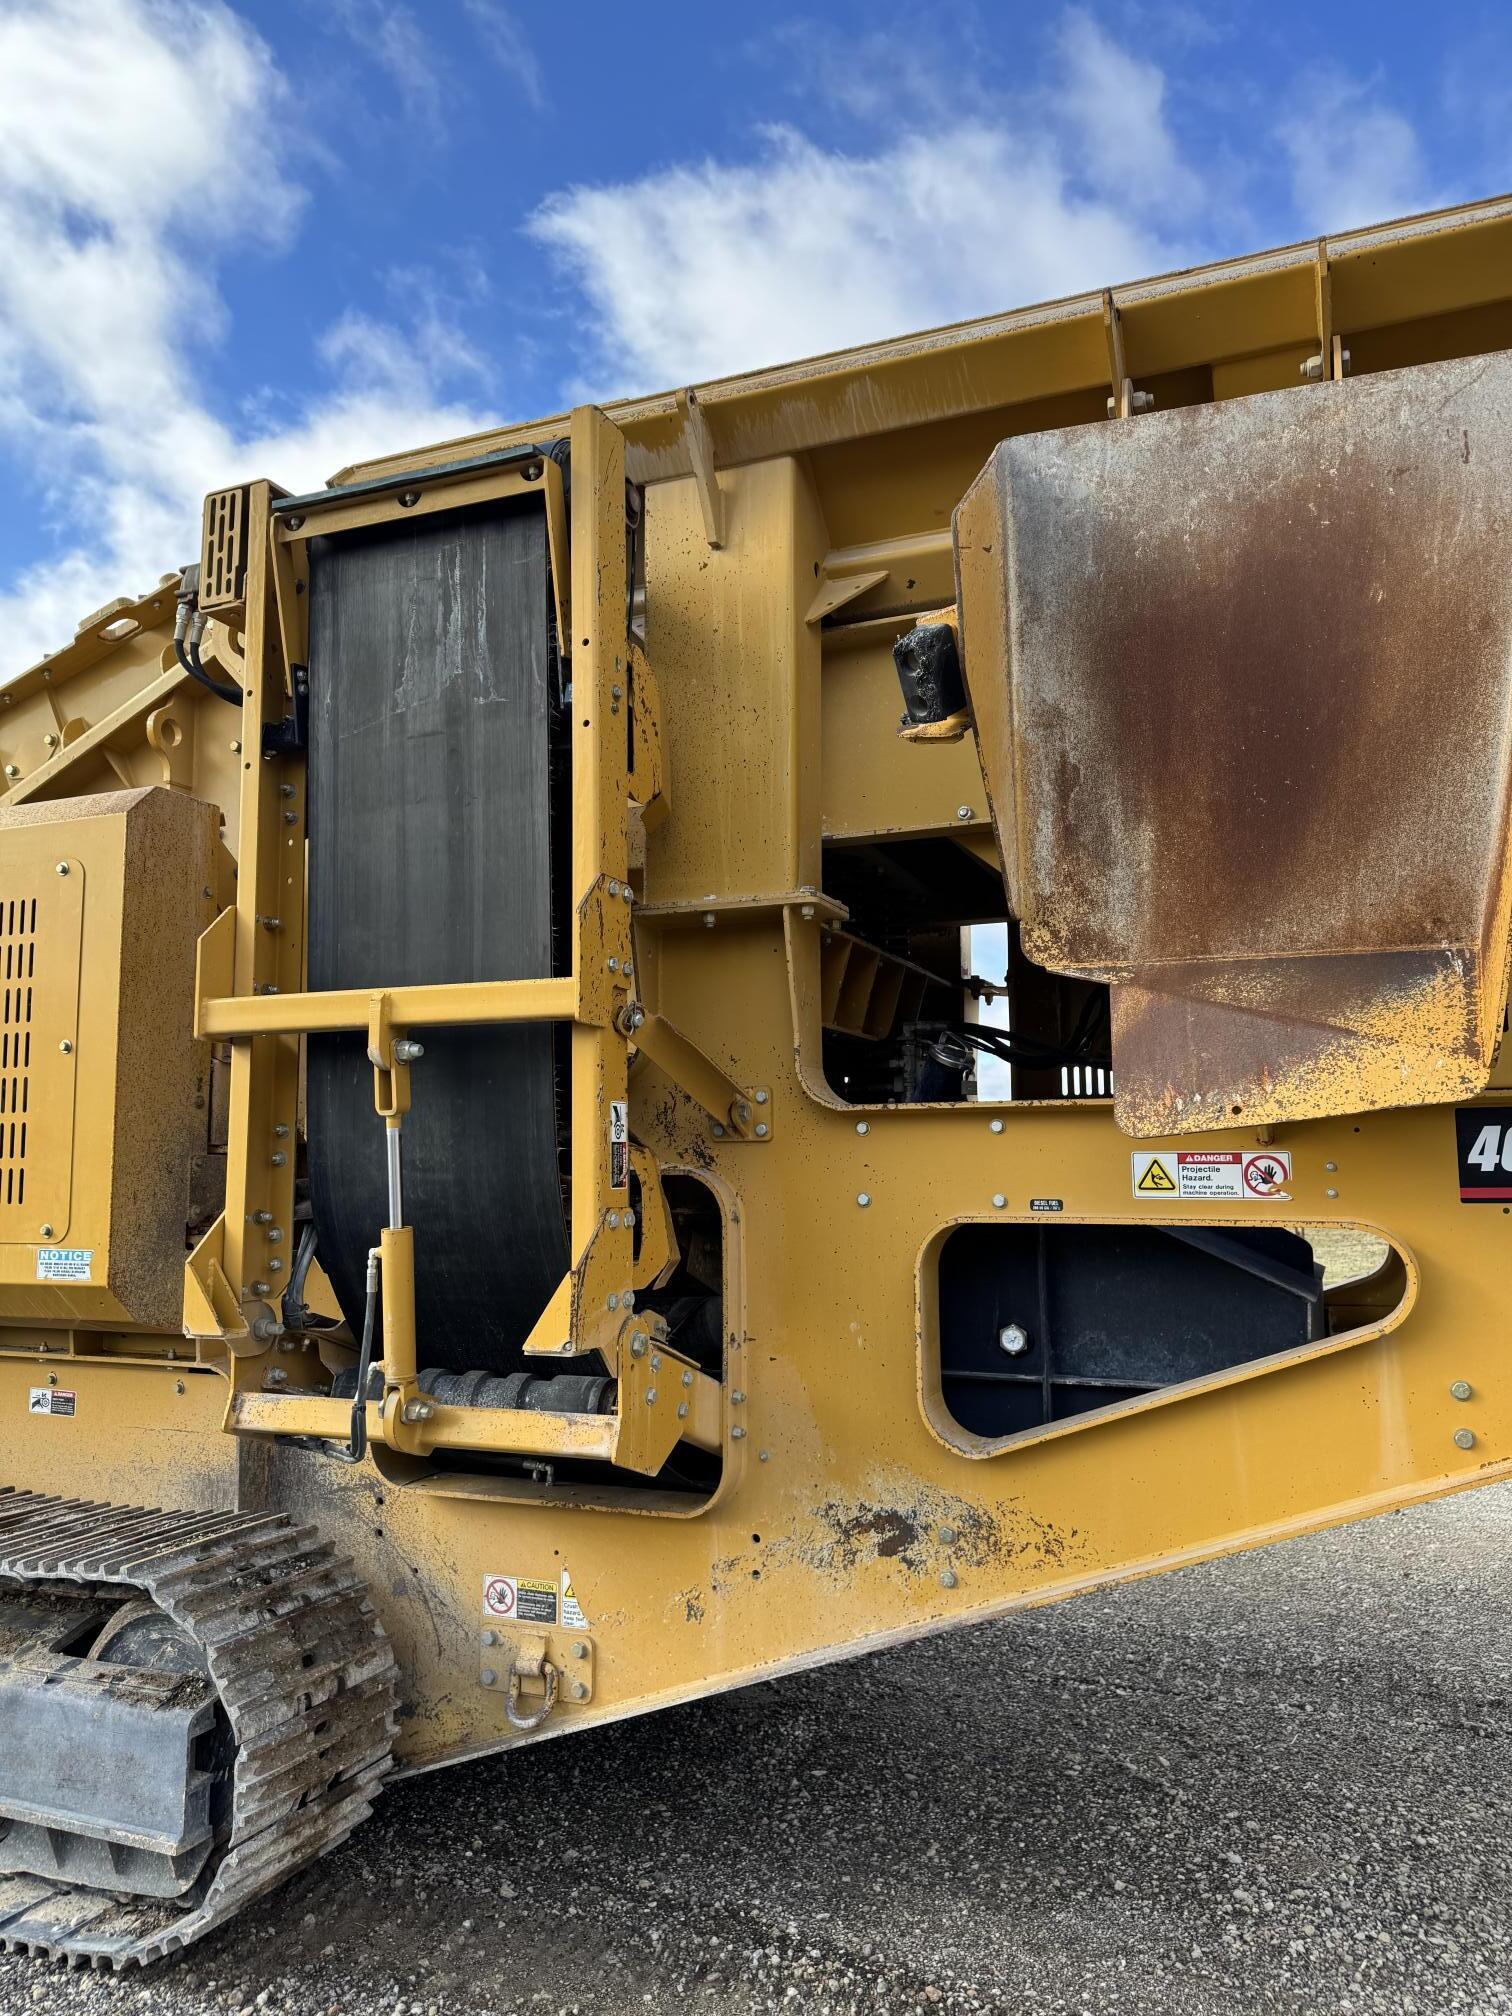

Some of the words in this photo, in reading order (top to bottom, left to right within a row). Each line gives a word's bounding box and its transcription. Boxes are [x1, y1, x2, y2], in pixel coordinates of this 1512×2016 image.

[1193, 1154, 1233, 1162] DANGER
[1181, 1165, 1221, 1174] Projectile
[40, 1250, 93, 1261] NOTICE
[526, 1581, 554, 1591] CAUTION
